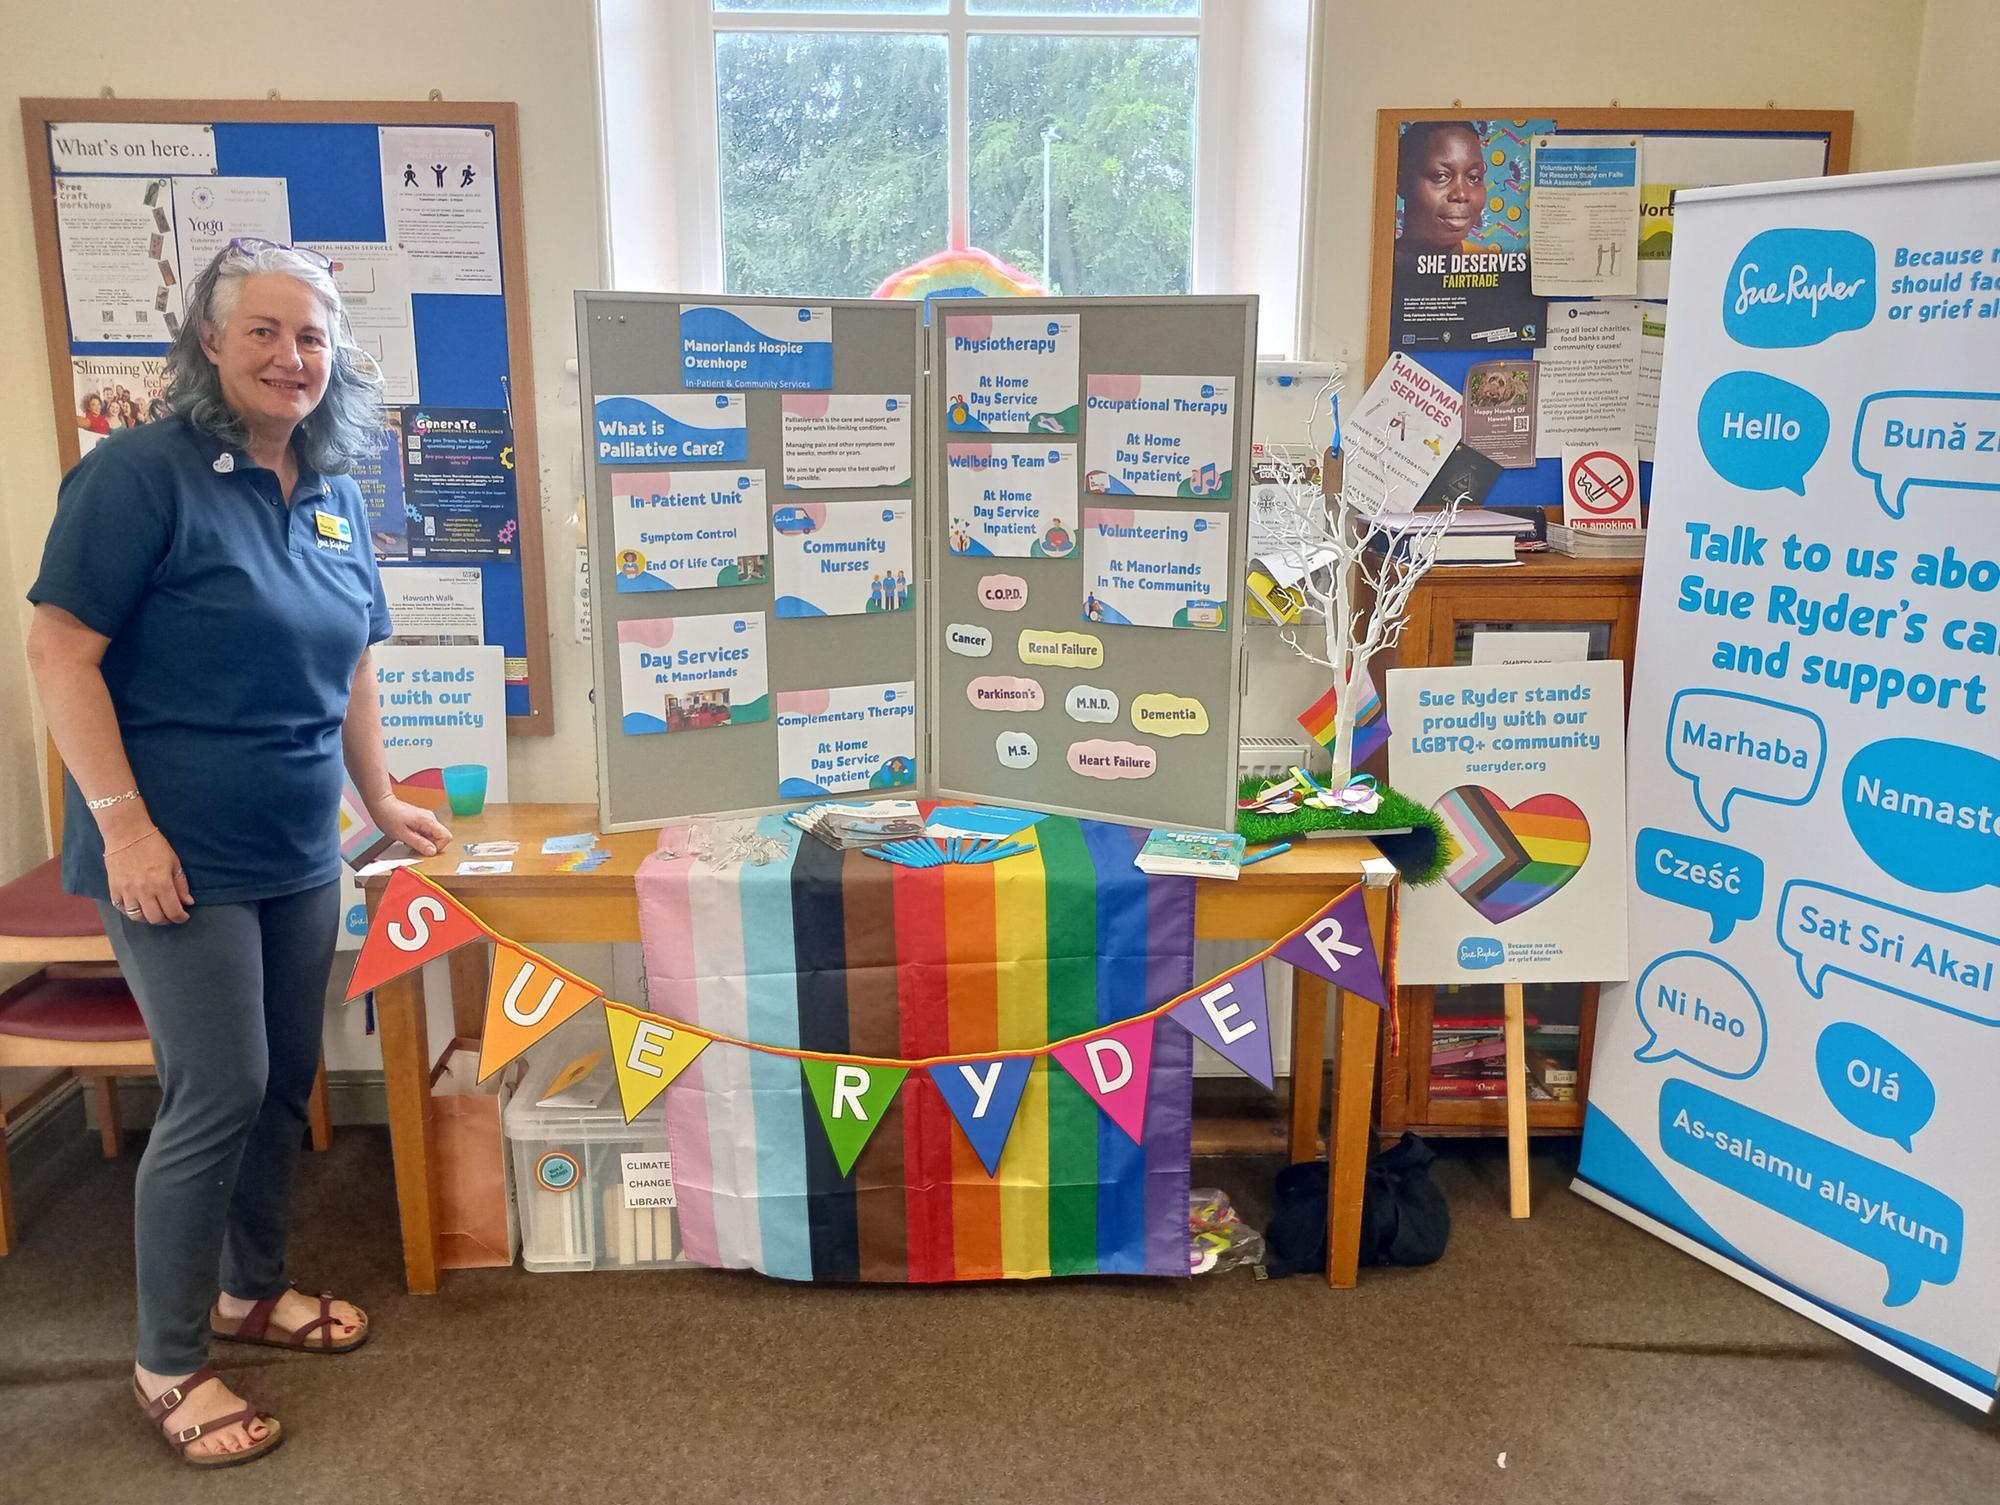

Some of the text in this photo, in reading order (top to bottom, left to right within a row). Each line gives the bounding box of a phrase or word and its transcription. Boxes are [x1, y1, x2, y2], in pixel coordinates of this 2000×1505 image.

[55, 138, 119, 157] What's
[124, 144, 145, 157] on
[60, 183, 82, 191] Free
[60, 192, 88, 200] Craft
[189, 218, 224, 236] Yoga
[1418, 253, 1527, 274] SHE DESERVES
[1895, 248, 1984, 268] Because
[1442, 274, 1499, 289] FAIRTRADE
[1891, 272, 1963, 294] should
[1734, 263, 1866, 319] Sue Ryder
[1888, 298, 1974, 324] or grief
[684, 340, 803, 357] Manorlands Hospice
[955, 336, 1056, 355] Physiotherapy
[76, 360, 140, 377] Slimming
[685, 356, 748, 372] Oxenhope
[686, 380, 810, 389] In-Patient & Community Services
[979, 376, 1029, 388] At Home
[970, 392, 1038, 406] Day Service
[1088, 396, 1228, 415] Occupational Therapy
[1390, 380, 1452, 428] SERVICES
[977, 409, 1031, 423] Inpatient
[599, 420, 664, 436] What is
[1722, 412, 1967, 451] Hello Bună
[1126, 433, 1181, 447] At Home
[600, 441, 724, 458] Palliative Care?
[1116, 450, 1190, 465] Day Service
[950, 455, 1045, 469] Wellbeing Team
[1122, 468, 1182, 483] Inpatient
[630, 491, 742, 508] In-Patient Unit
[984, 490, 1032, 501] At Home
[974, 506, 1040, 519] Day Service
[984, 522, 1037, 536] Inpatient
[1572, 520, 1588, 529] No
[640, 528, 737, 544] Symptom Control
[1098, 523, 1189, 543] Volunteering
[803, 538, 886, 554] Community
[1686, 522, 1768, 566] Talk
[1783, 534, 1831, 572] to
[1846, 548, 1898, 580] us
[646, 557, 734, 572] End Of Life Care
[821, 560, 869, 573] Nurses
[1110, 560, 1201, 575] At Manorlands
[1097, 576, 1210, 595] In The Community
[985, 588, 1023, 600] C.O.P.D.
[1678, 574, 1754, 620] Sue
[952, 633, 986, 646] Cancer
[1028, 642, 1098, 656] Renal Failure
[640, 647, 750, 670] Day Services
[377, 667, 475, 683] der stands
[656, 668, 738, 684] At Manorlands
[1712, 641, 1986, 715] and support
[391, 690, 472, 705] with our
[977, 688, 1036, 700] Parkinson's
[1419, 685, 1591, 708] Sue Ryder stands
[1076, 698, 1110, 710] M.N.D.
[381, 711, 484, 728] community
[777, 705, 914, 727] Complementary Therapy
[1141, 708, 1196, 720] Dementia
[1423, 710, 1588, 734] proudly with our
[818, 740, 868, 754] At Home
[1412, 731, 1600, 754] LGBTQ+ community
[1683, 720, 1808, 769] Marhaba
[1008, 745, 1030, 757] M.S.
[811, 753, 880, 770] Day Service
[1079, 754, 1151, 768] Heart Failure
[1466, 761, 1546, 773] sueryder.org
[816, 769, 870, 787] Inpatient
[1655, 848, 1742, 896] Cześć
[1461, 946, 1501, 962] Sue Ryder
[1800, 906, 1994, 991] Sat Sri Akal
[1658, 985, 1746, 1039] Ni hao
[1846, 1060, 1901, 1102] Olá
[627, 1161, 670, 1170] CLIMATE
[630, 1180, 672, 1188] CHANGE
[1672, 1108, 1950, 1255] As-salamu alaykum
[630, 1198, 673, 1206] LIBRARY
